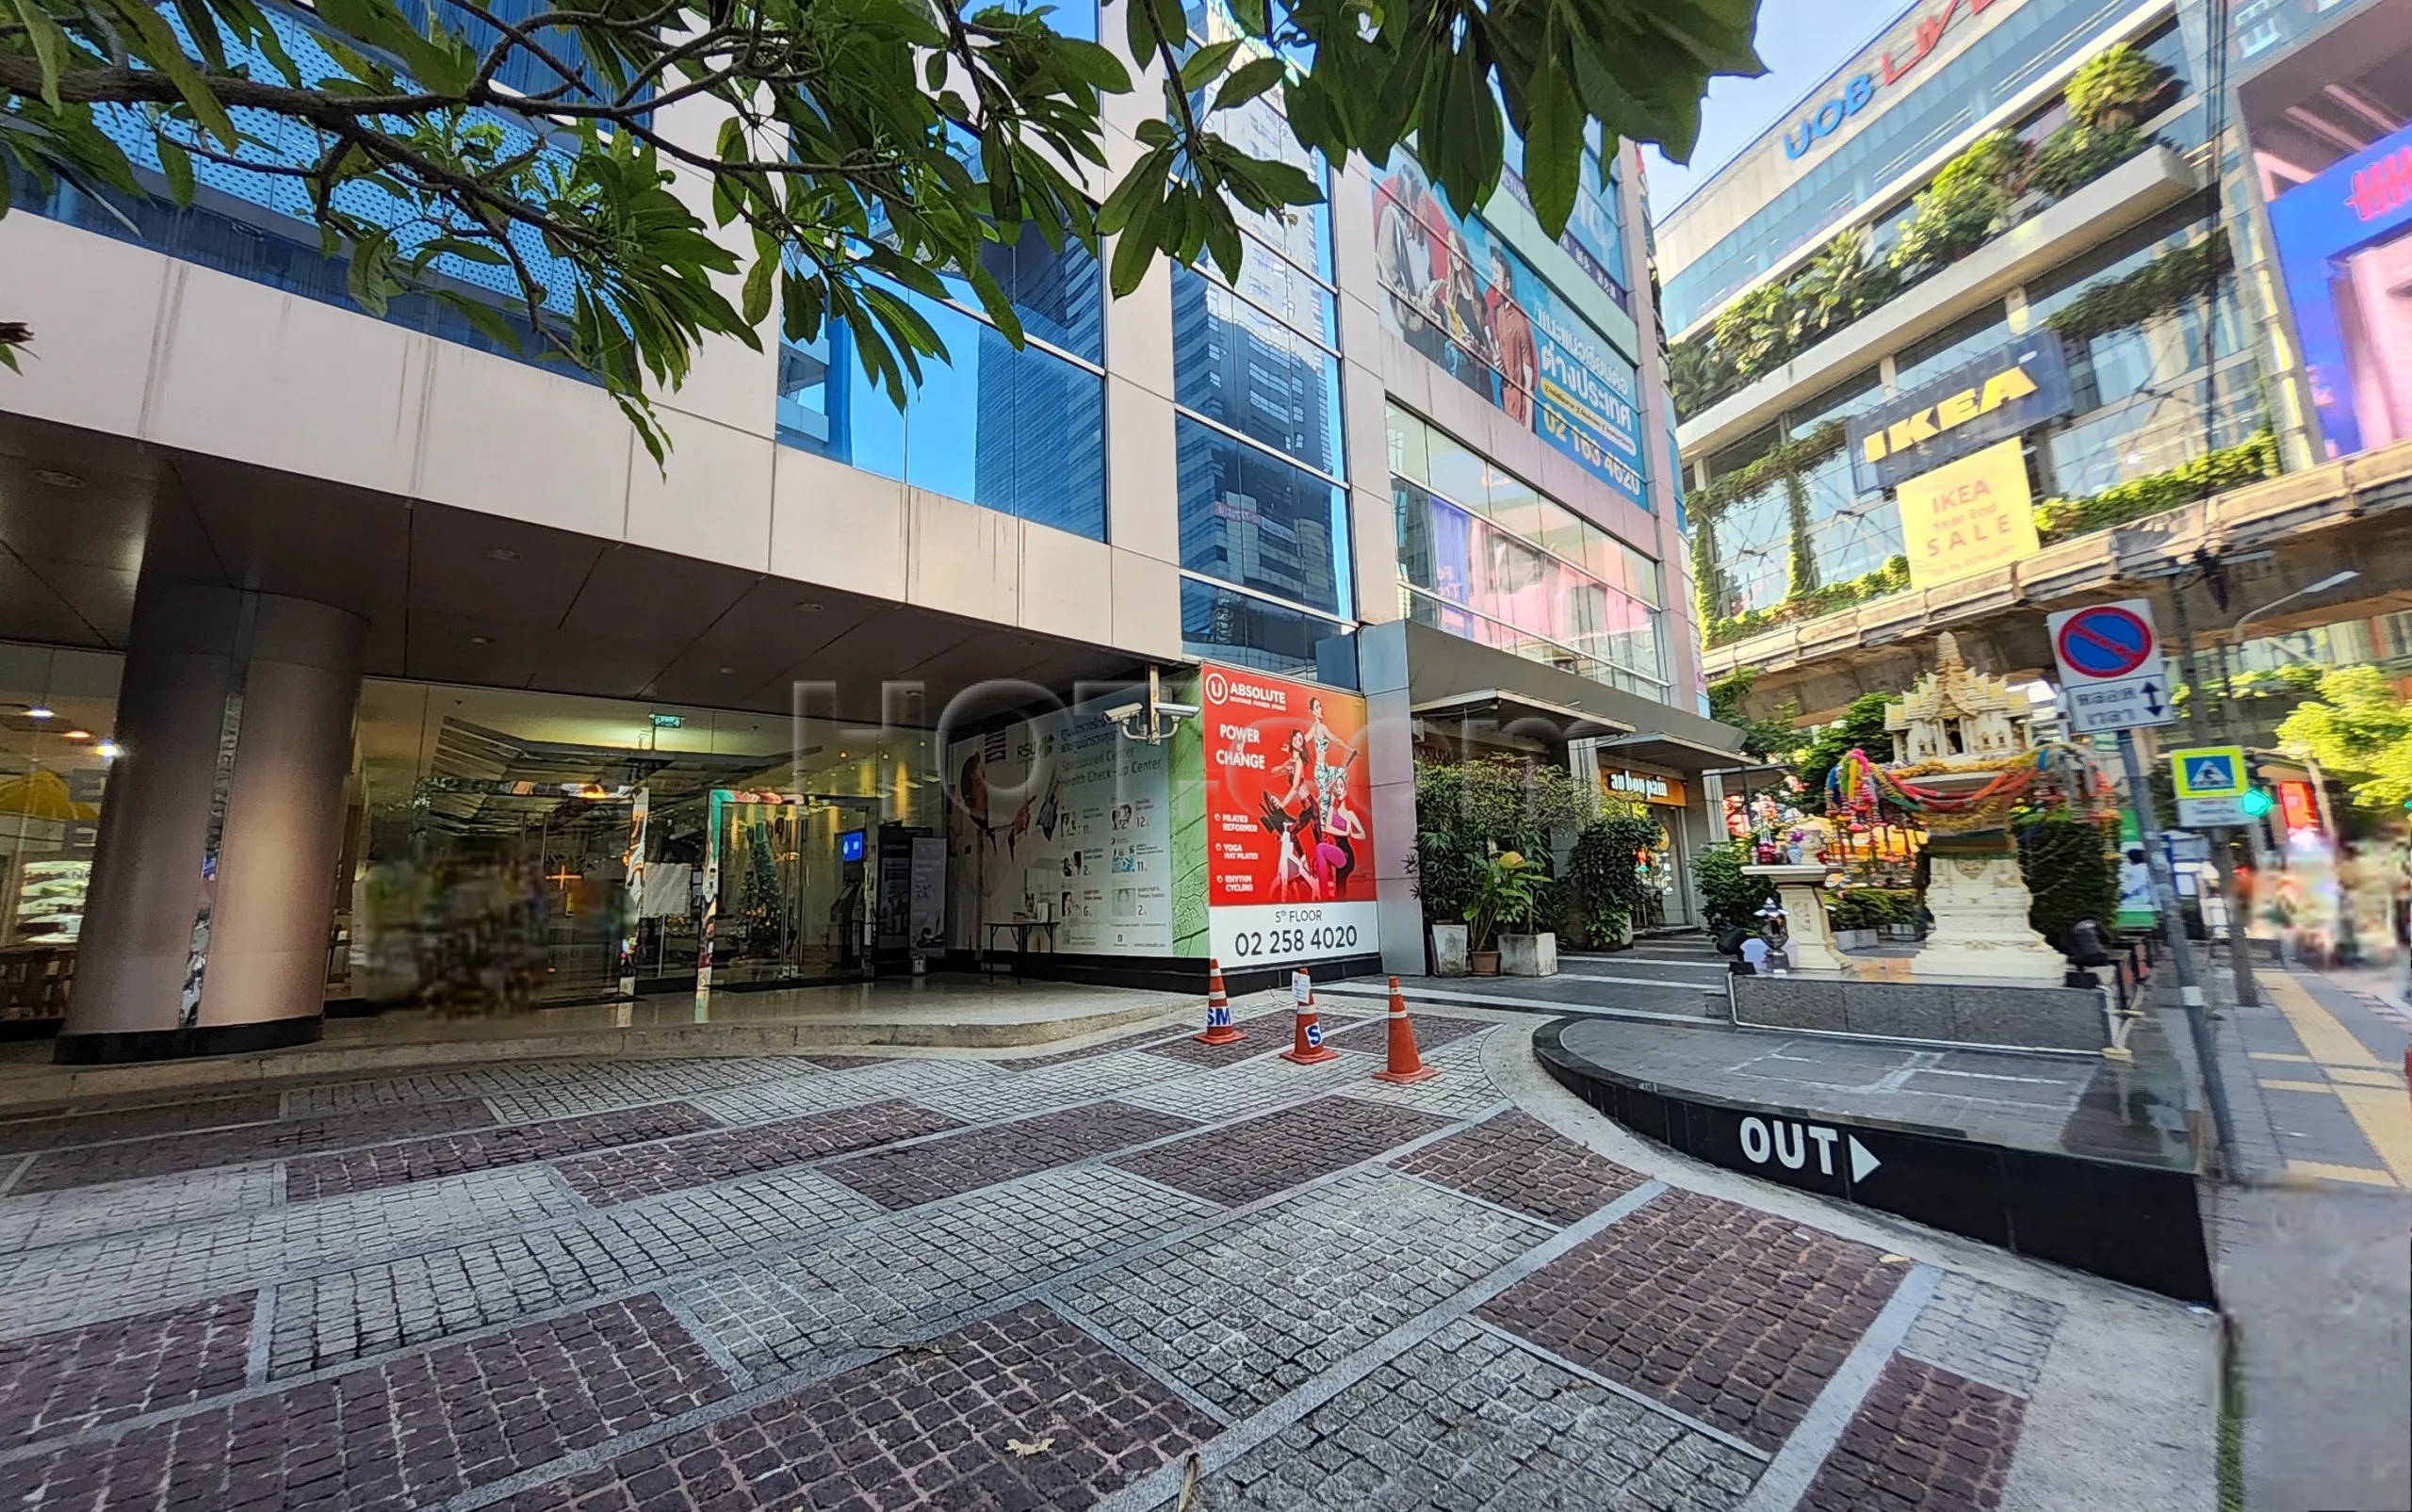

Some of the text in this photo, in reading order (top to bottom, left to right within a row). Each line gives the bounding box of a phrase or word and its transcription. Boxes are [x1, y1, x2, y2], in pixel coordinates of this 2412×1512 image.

[1783, 0, 1996, 159] UOB LIV
[1540, 340, 1632, 431] ต่างประเทศ
[1543, 403, 1567, 442] 02
[1863, 366, 2039, 463] IKEA
[1931, 480, 1992, 514] IKEA
[1927, 513, 2012, 558] SALE
[1230, 682, 1287, 705] ABSOLUTE
[1219, 723, 1261, 743] POWER
[1132, 757, 1162, 773] Center
[1215, 749, 1265, 770] CHANGE
[1136, 816, 1146, 828] 12
[1222, 814, 1248, 824] PILATES
[1223, 843, 1243, 852] YOGA
[1225, 884, 1254, 892] CYCLING
[1289, 909, 1323, 923] FLOOR
[1235, 924, 1358, 957] 02 258 4020
[1740, 1116, 1838, 1176] OUT
